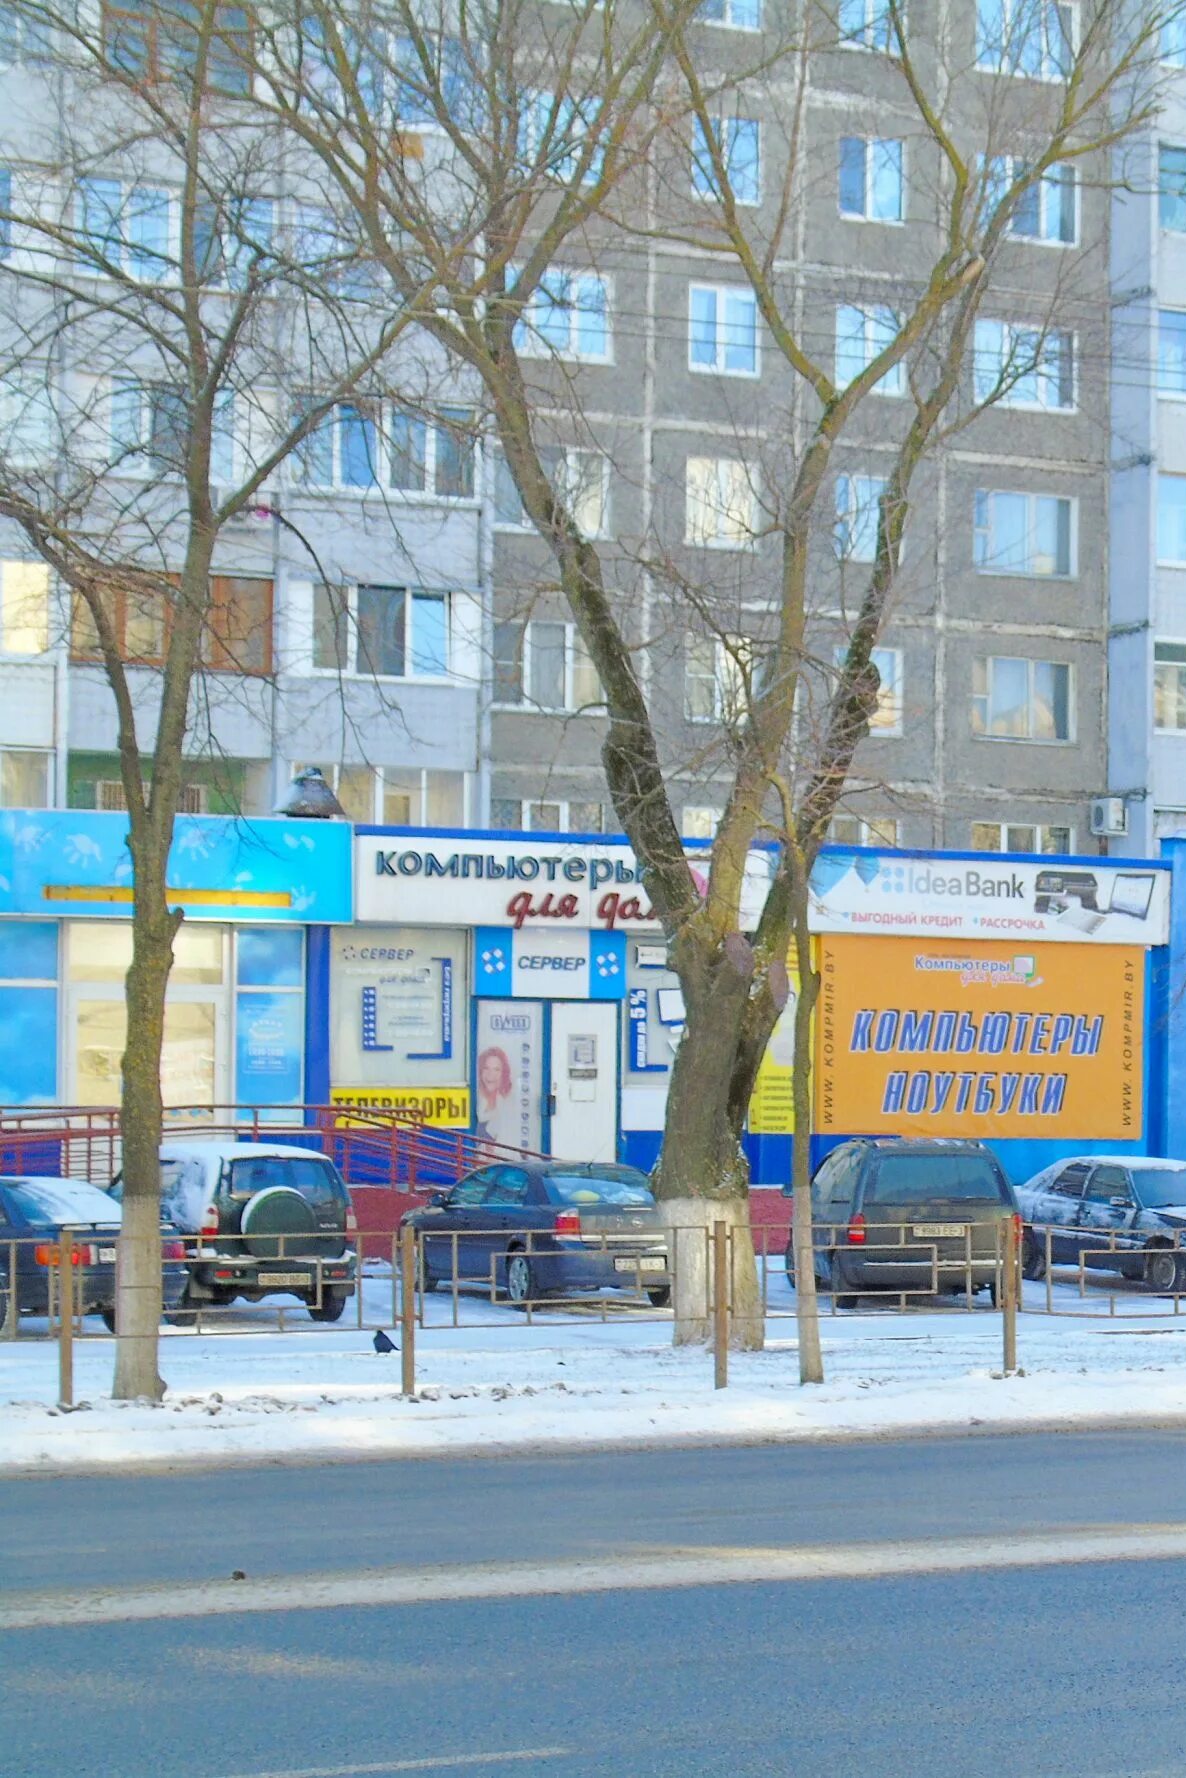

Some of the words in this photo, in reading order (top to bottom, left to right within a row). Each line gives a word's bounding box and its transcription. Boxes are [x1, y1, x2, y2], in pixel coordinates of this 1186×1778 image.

[506, 891, 579, 929] для
[851, 912, 917, 925] ВЫГОДНЫЙ
[921, 915, 963, 928] КРЕДИТ
[980, 918, 1046, 930] РАССРОЧКА
[360, 948, 414, 960] СЕРВЕР
[518, 956, 586, 971] СЕРВЕР
[915, 957, 1010, 973] Компьютеры
[850, 1009, 1104, 1056] КОМПЬЮТЕРЫ
[880, 1070, 1068, 1116] НОУТБУКИ
